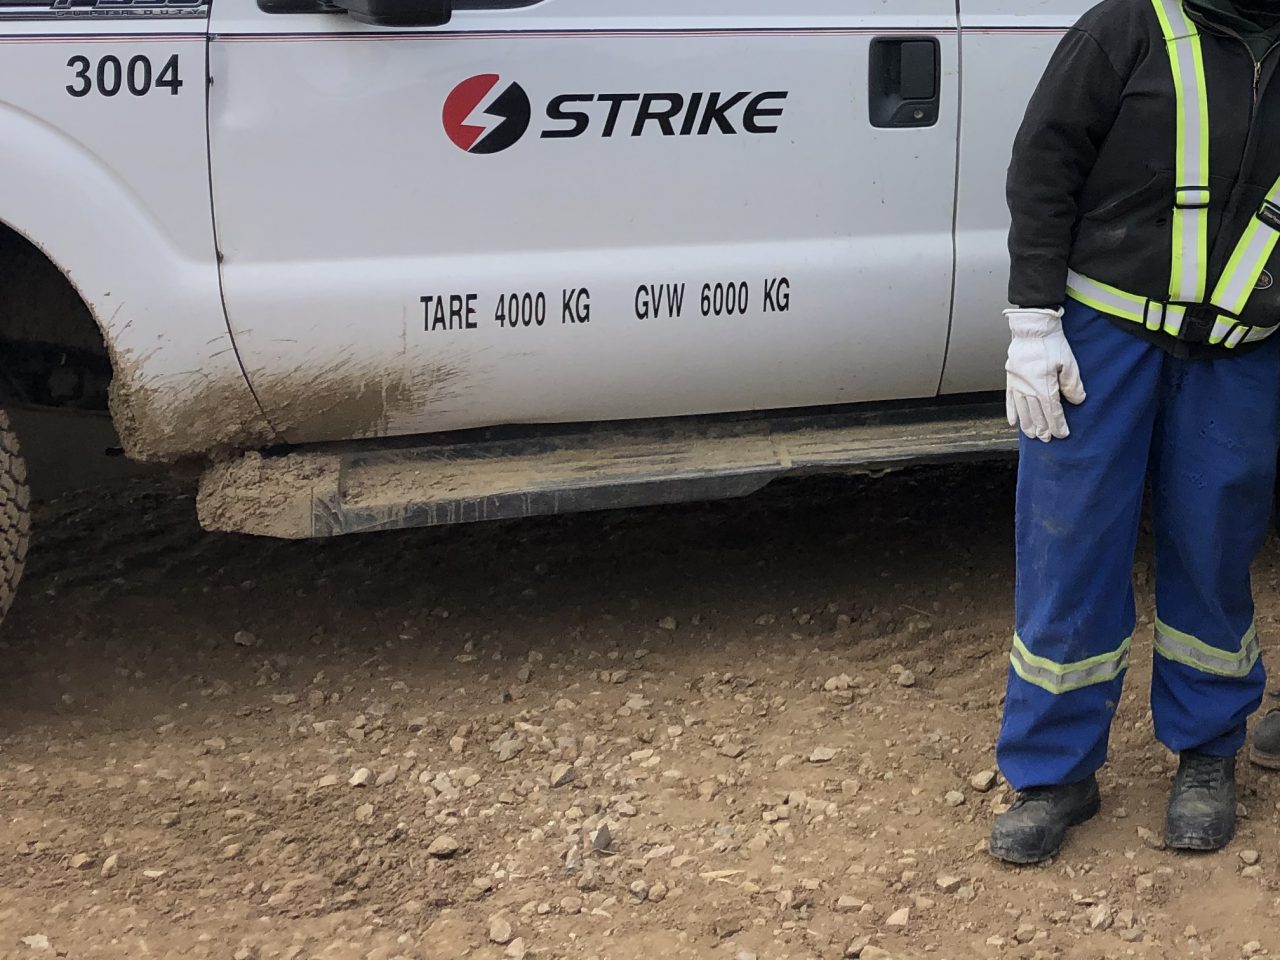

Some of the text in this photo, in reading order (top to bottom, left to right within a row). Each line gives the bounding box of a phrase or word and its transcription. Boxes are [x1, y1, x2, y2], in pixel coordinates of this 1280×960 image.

[143, 9, 206, 17] DUTY
[65, 53, 183, 98] 3004
[539, 90, 789, 139] STRIKE
[419, 276, 791, 331] TARE 4000 KG GVW 6000 KG
